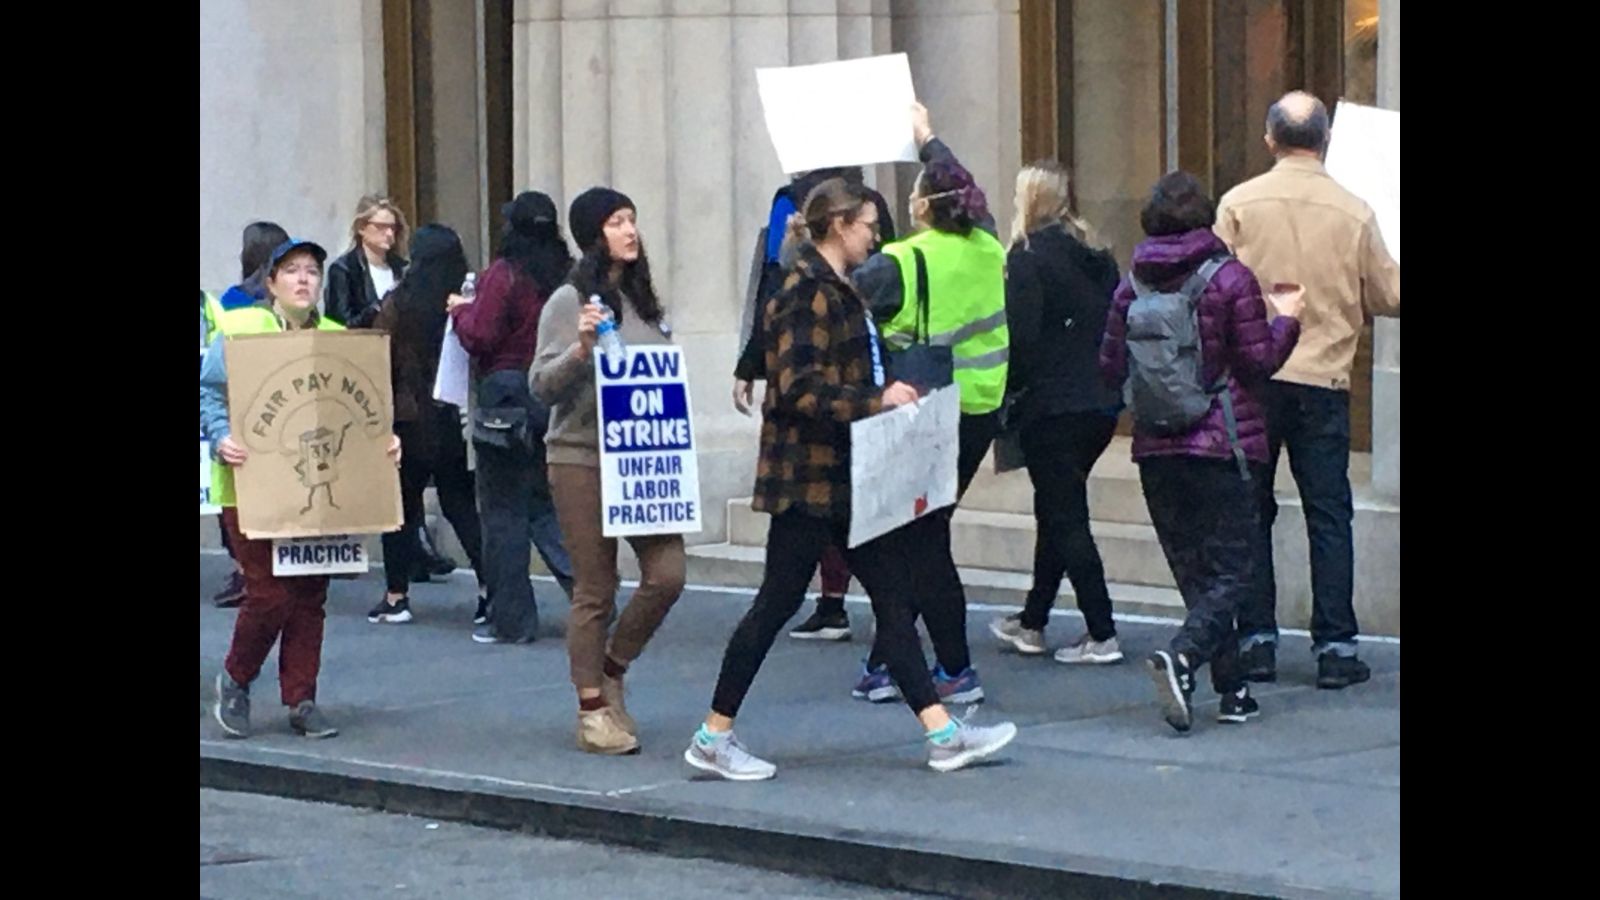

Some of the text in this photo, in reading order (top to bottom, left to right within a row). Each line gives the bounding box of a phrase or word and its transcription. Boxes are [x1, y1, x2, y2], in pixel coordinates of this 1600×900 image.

[600, 352, 679, 380] UAW
[252, 390, 288, 437] FAIR
[292, 373, 333, 394] PAY
[630, 388, 665, 417] ON
[606, 418, 689, 448] STRIKE
[618, 455, 682, 477] UNFAIR
[622, 479, 681, 501] LABOR
[608, 501, 696, 525] PRACTICE
[278, 543, 362, 565] PRACTICE
